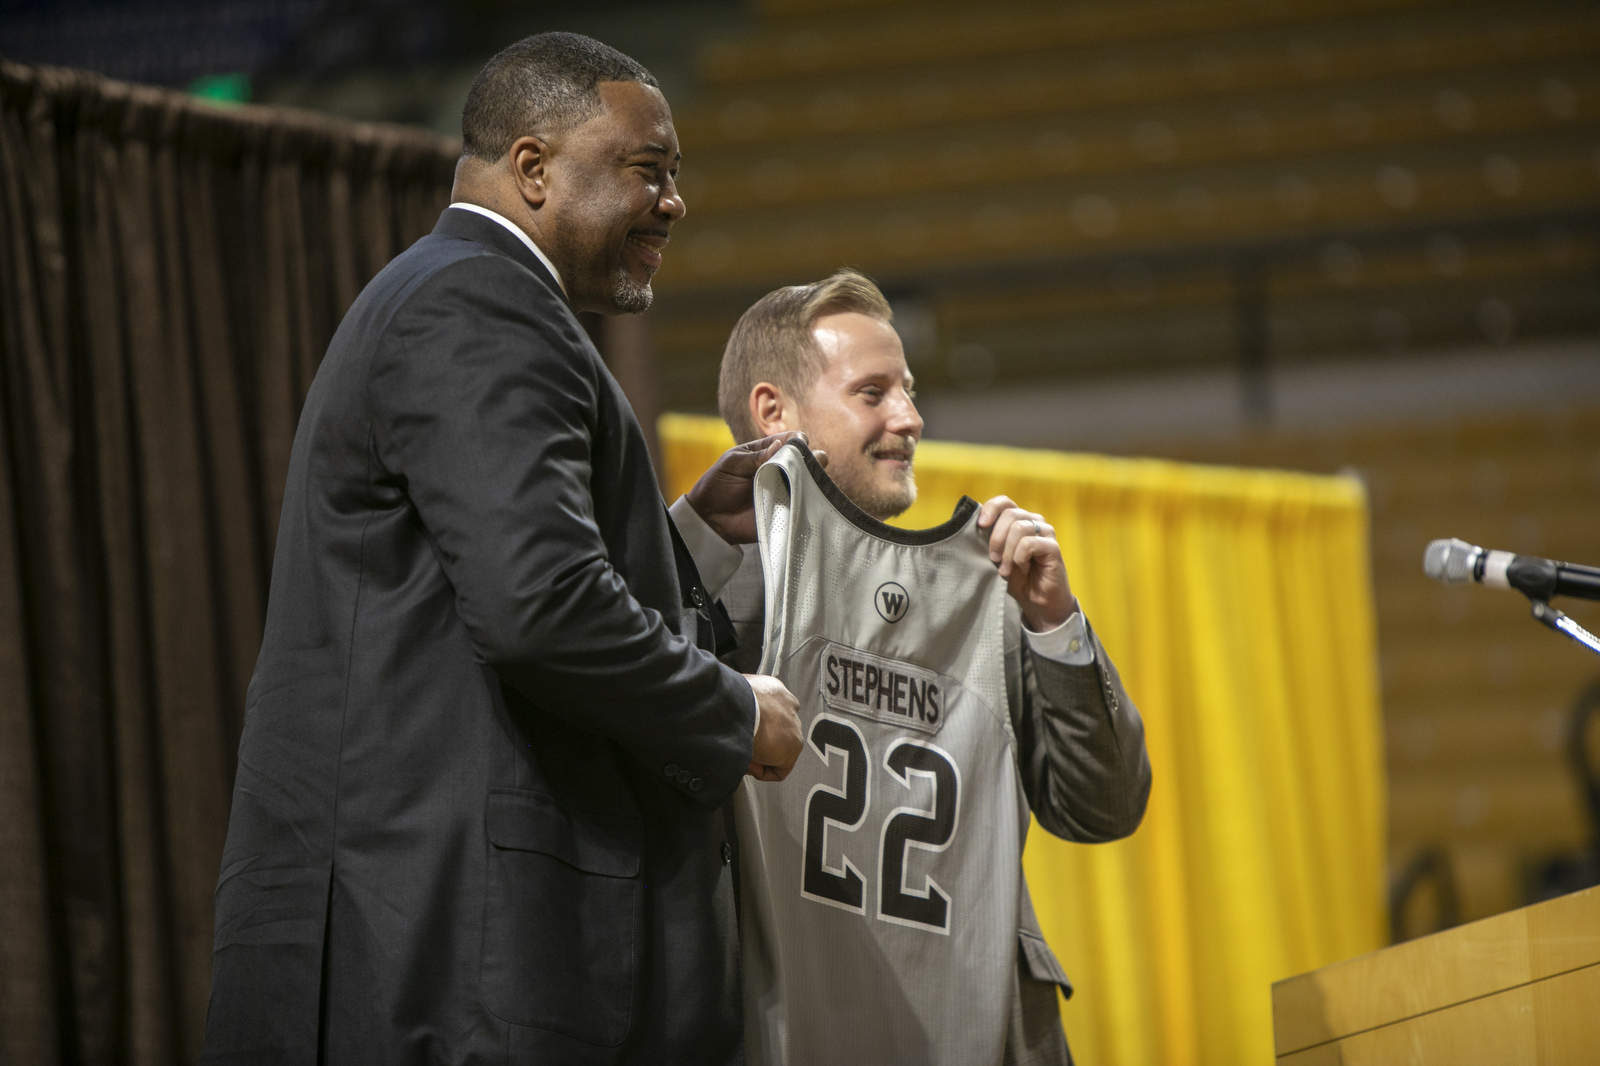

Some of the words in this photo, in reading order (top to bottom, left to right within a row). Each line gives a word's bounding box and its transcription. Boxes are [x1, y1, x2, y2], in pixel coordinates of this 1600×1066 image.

[882, 591, 904, 616] W
[826, 654, 939, 725] STEPHENS
[801, 712, 962, 936] 22
